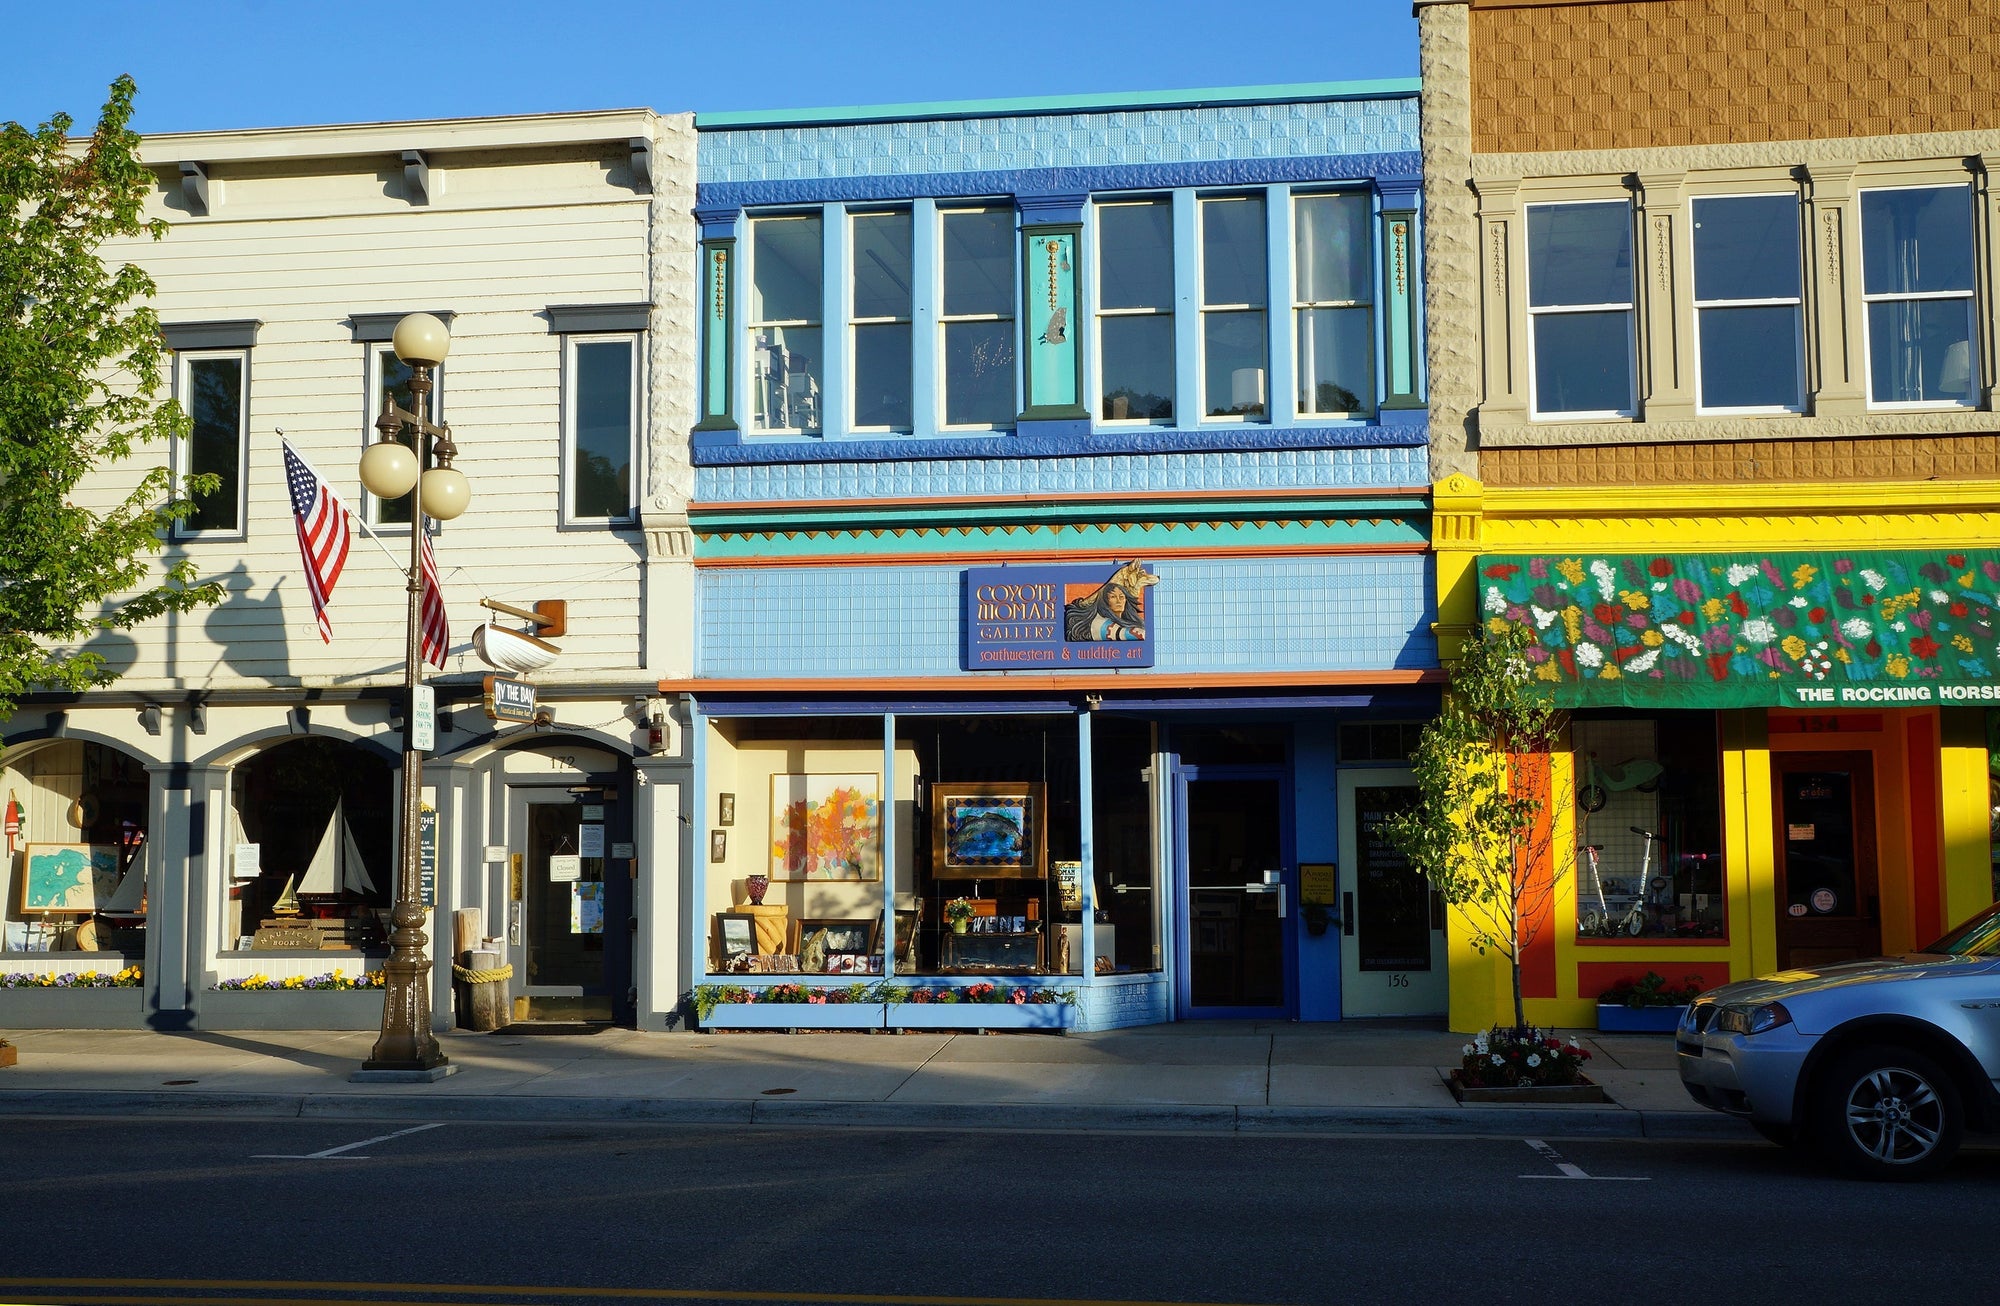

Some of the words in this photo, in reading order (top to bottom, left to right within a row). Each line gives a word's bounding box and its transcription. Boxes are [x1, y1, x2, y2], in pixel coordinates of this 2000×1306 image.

[976, 583, 1057, 603] COYOTE
[977, 602, 1056, 621] WOMAN
[980, 625, 1055, 640] GALLERY
[980, 647, 1055, 662] southwestern
[1061, 647, 1072, 661] &
[1077, 645, 1121, 663] wildlife
[1126, 647, 1143, 661] art
[495, 681, 506, 706] BY
[506, 684, 520, 702] THE
[520, 686, 535, 712] BAY
[1797, 687, 1835, 702] THE
[1842, 686, 1932, 702] ROCKING
[551, 755, 576, 769] 172
[260, 930, 314, 945] NAUTICAL
[1388, 974, 1409, 988] 156
